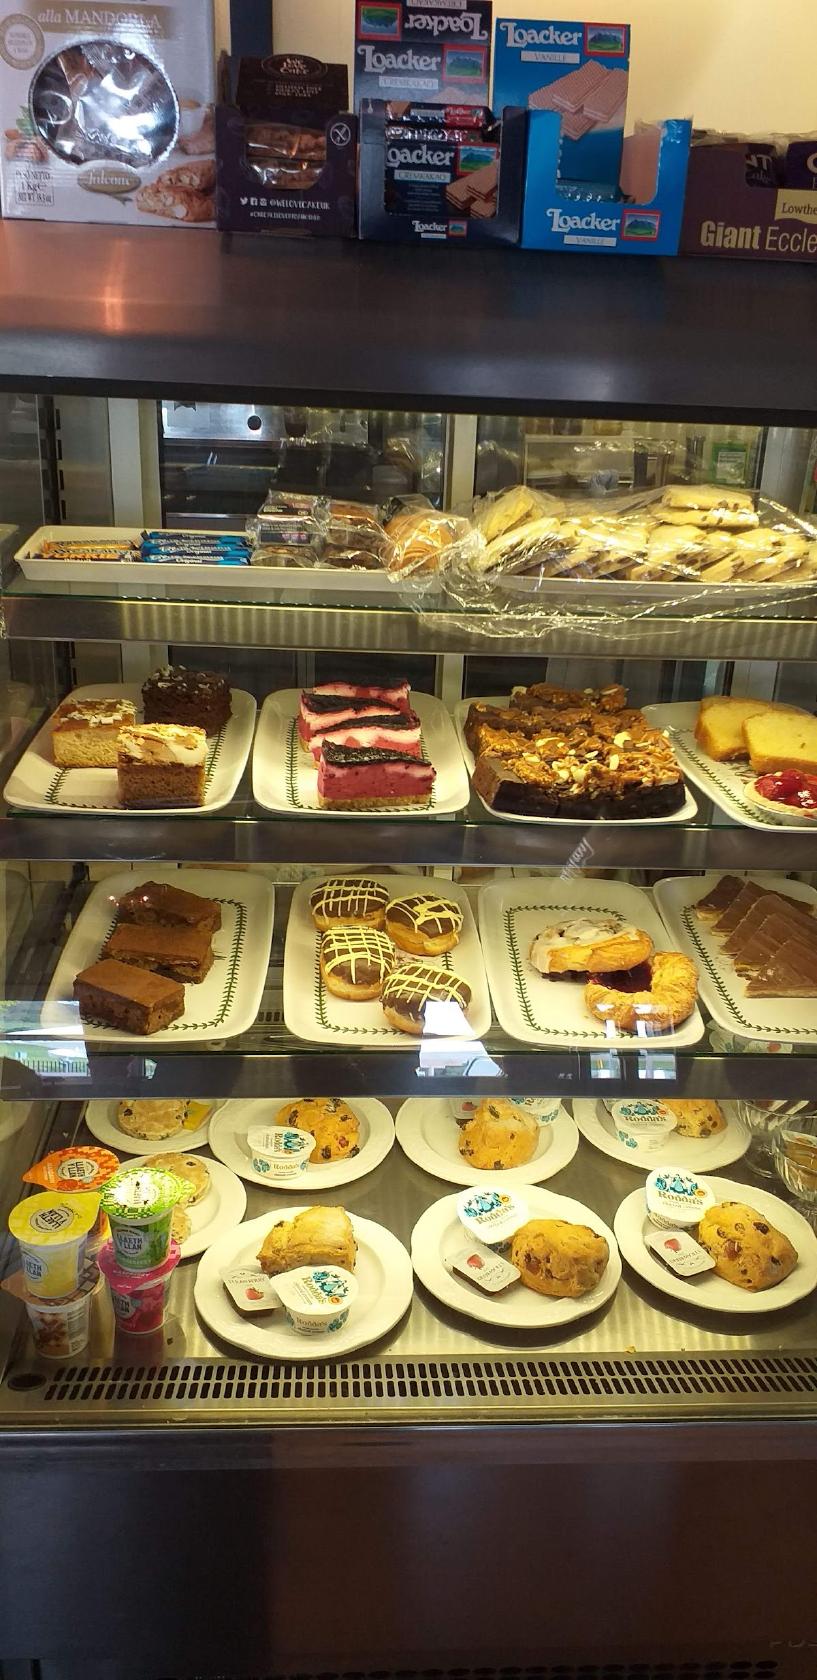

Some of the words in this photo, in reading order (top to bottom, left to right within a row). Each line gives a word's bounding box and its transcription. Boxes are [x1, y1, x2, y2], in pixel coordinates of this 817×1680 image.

[38, 9, 62, 24] alla
[404, 11, 488, 40] Loacker
[500, 22, 583, 48] Loacker
[357, 45, 441, 73] Loacker
[412, 220, 448, 233] Loacker
[546, 208, 621, 233] Loacker
[701, 220, 762, 250] Giant
